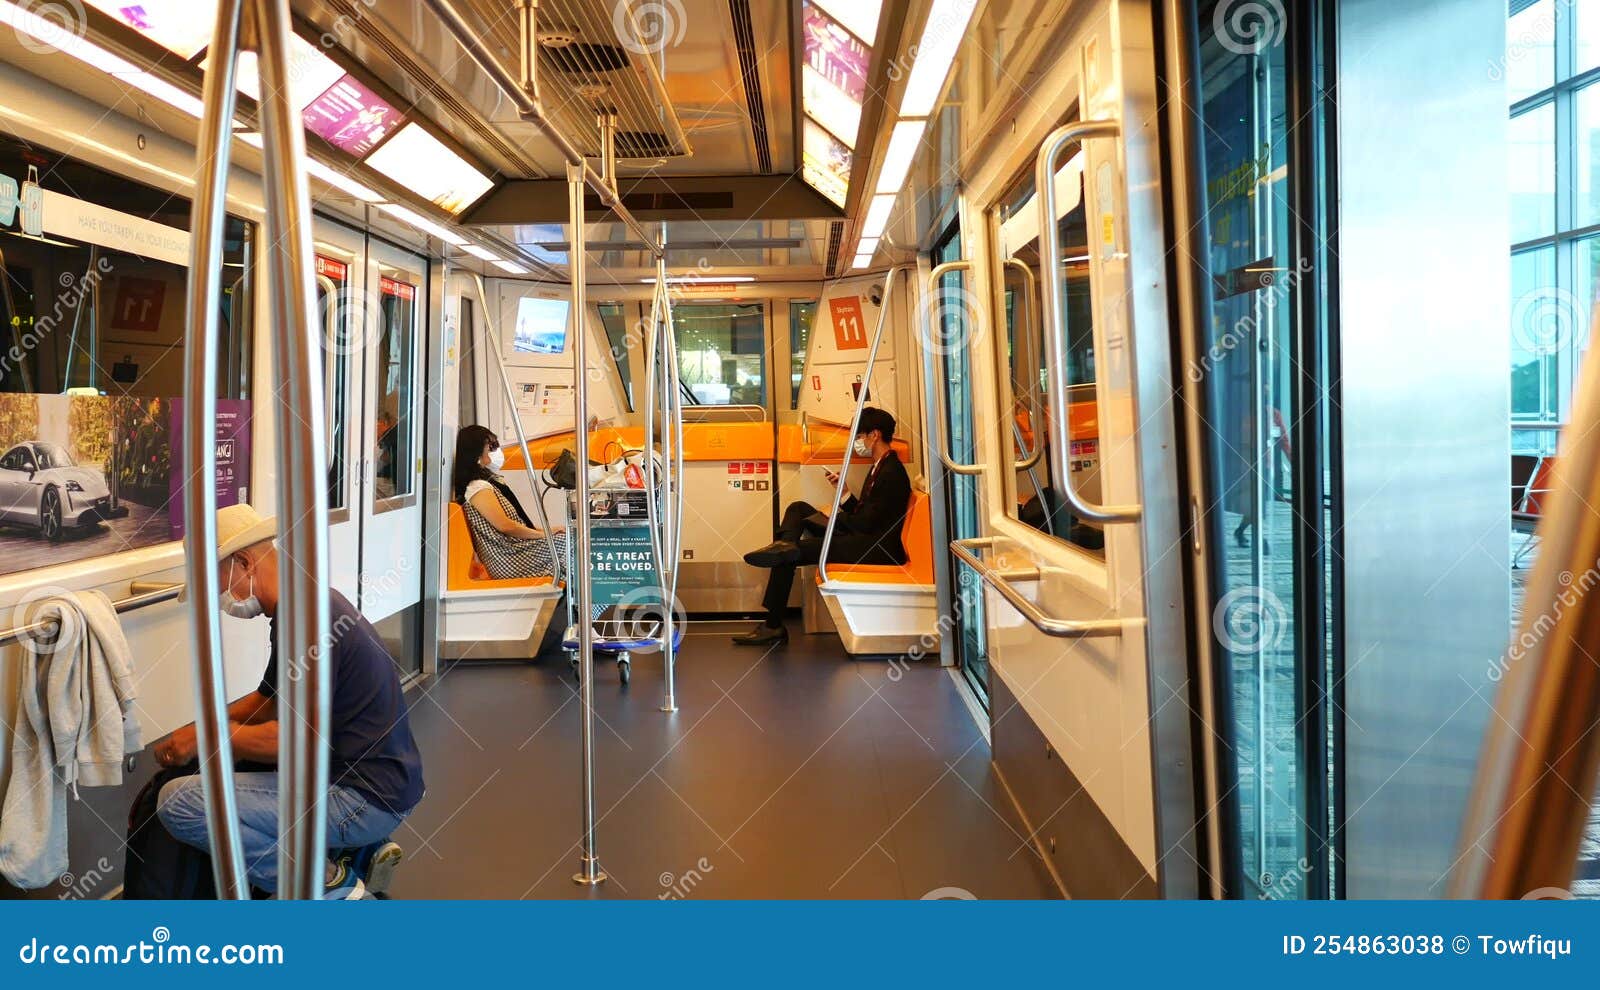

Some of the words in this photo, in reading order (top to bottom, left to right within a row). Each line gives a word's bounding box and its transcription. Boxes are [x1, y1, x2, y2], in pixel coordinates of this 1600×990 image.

[839, 316, 861, 341] 11
[606, 552, 614, 561] A
[616, 552, 651, 561] TREAT
[597, 562, 612, 571] BE
[615, 562, 655, 571] LOVED.
